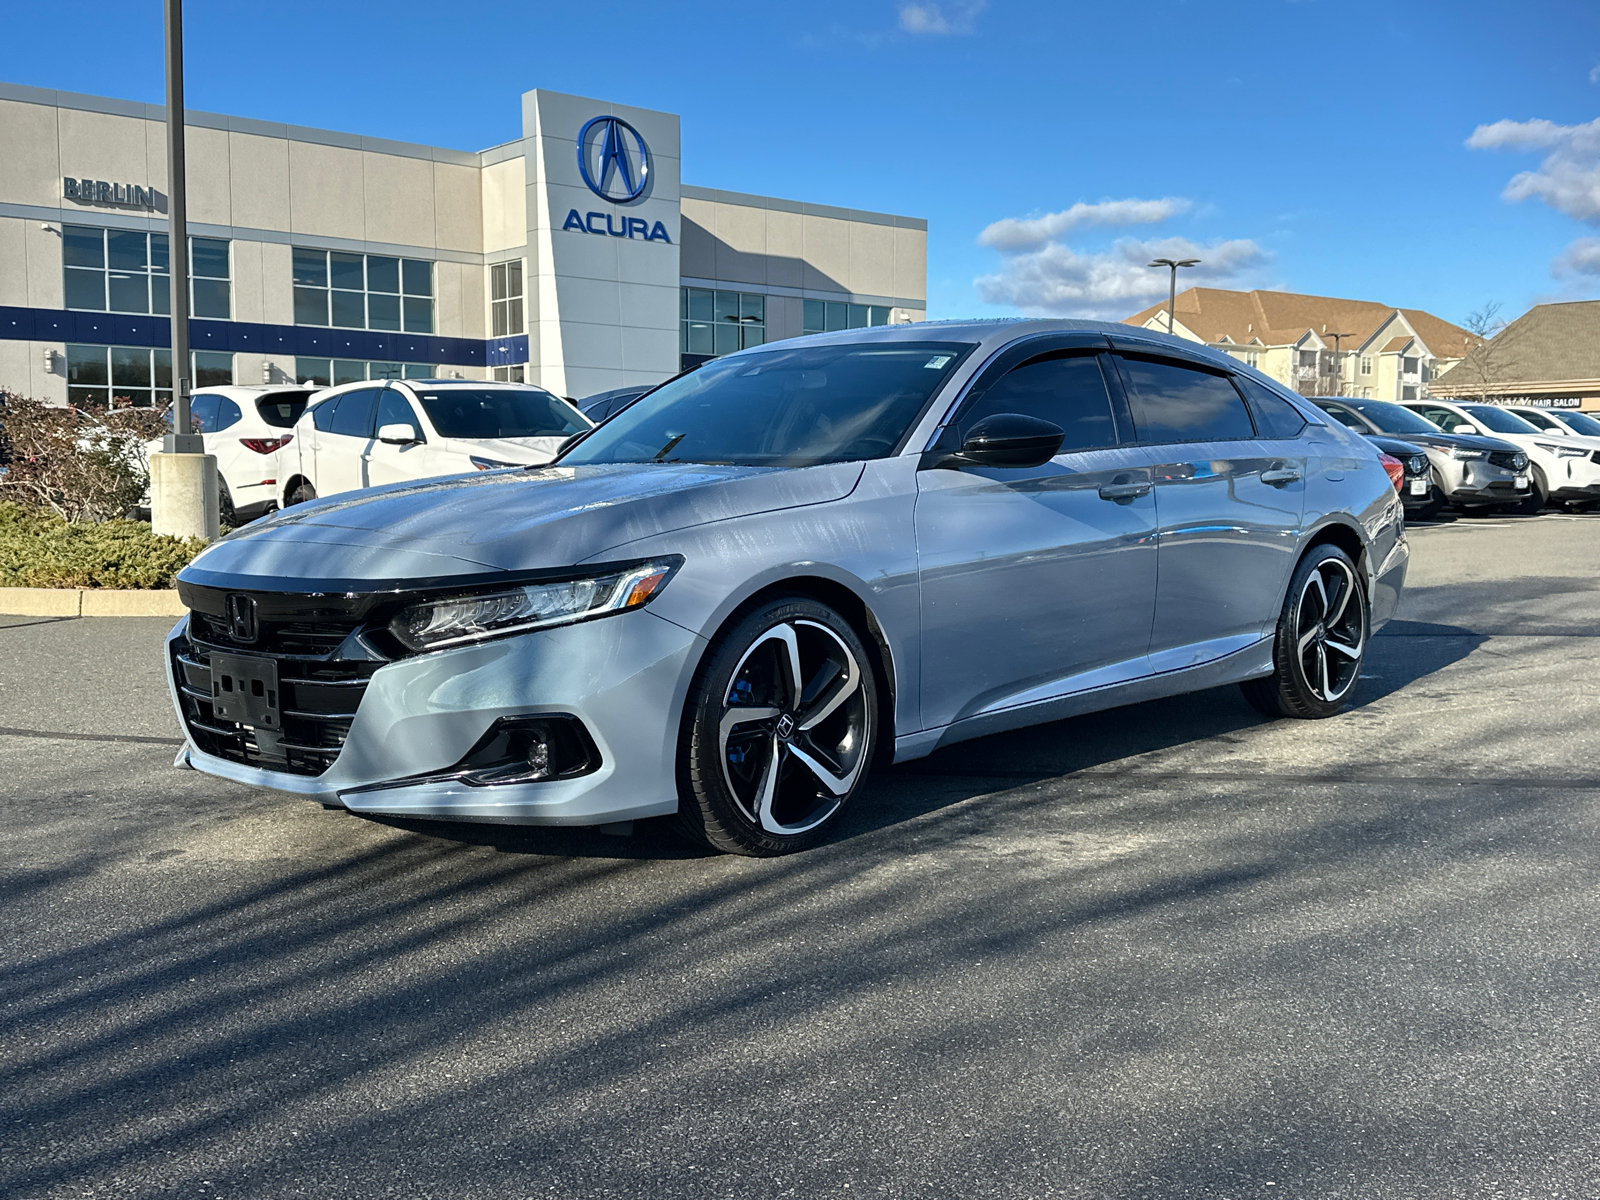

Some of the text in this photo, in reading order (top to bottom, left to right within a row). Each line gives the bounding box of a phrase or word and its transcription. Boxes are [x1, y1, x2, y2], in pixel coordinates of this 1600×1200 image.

[63, 177, 154, 207] BERLIN
[562, 208, 672, 243] ACURA
[1532, 398, 1552, 408] HAIR
[1553, 397, 1580, 407] SALON
